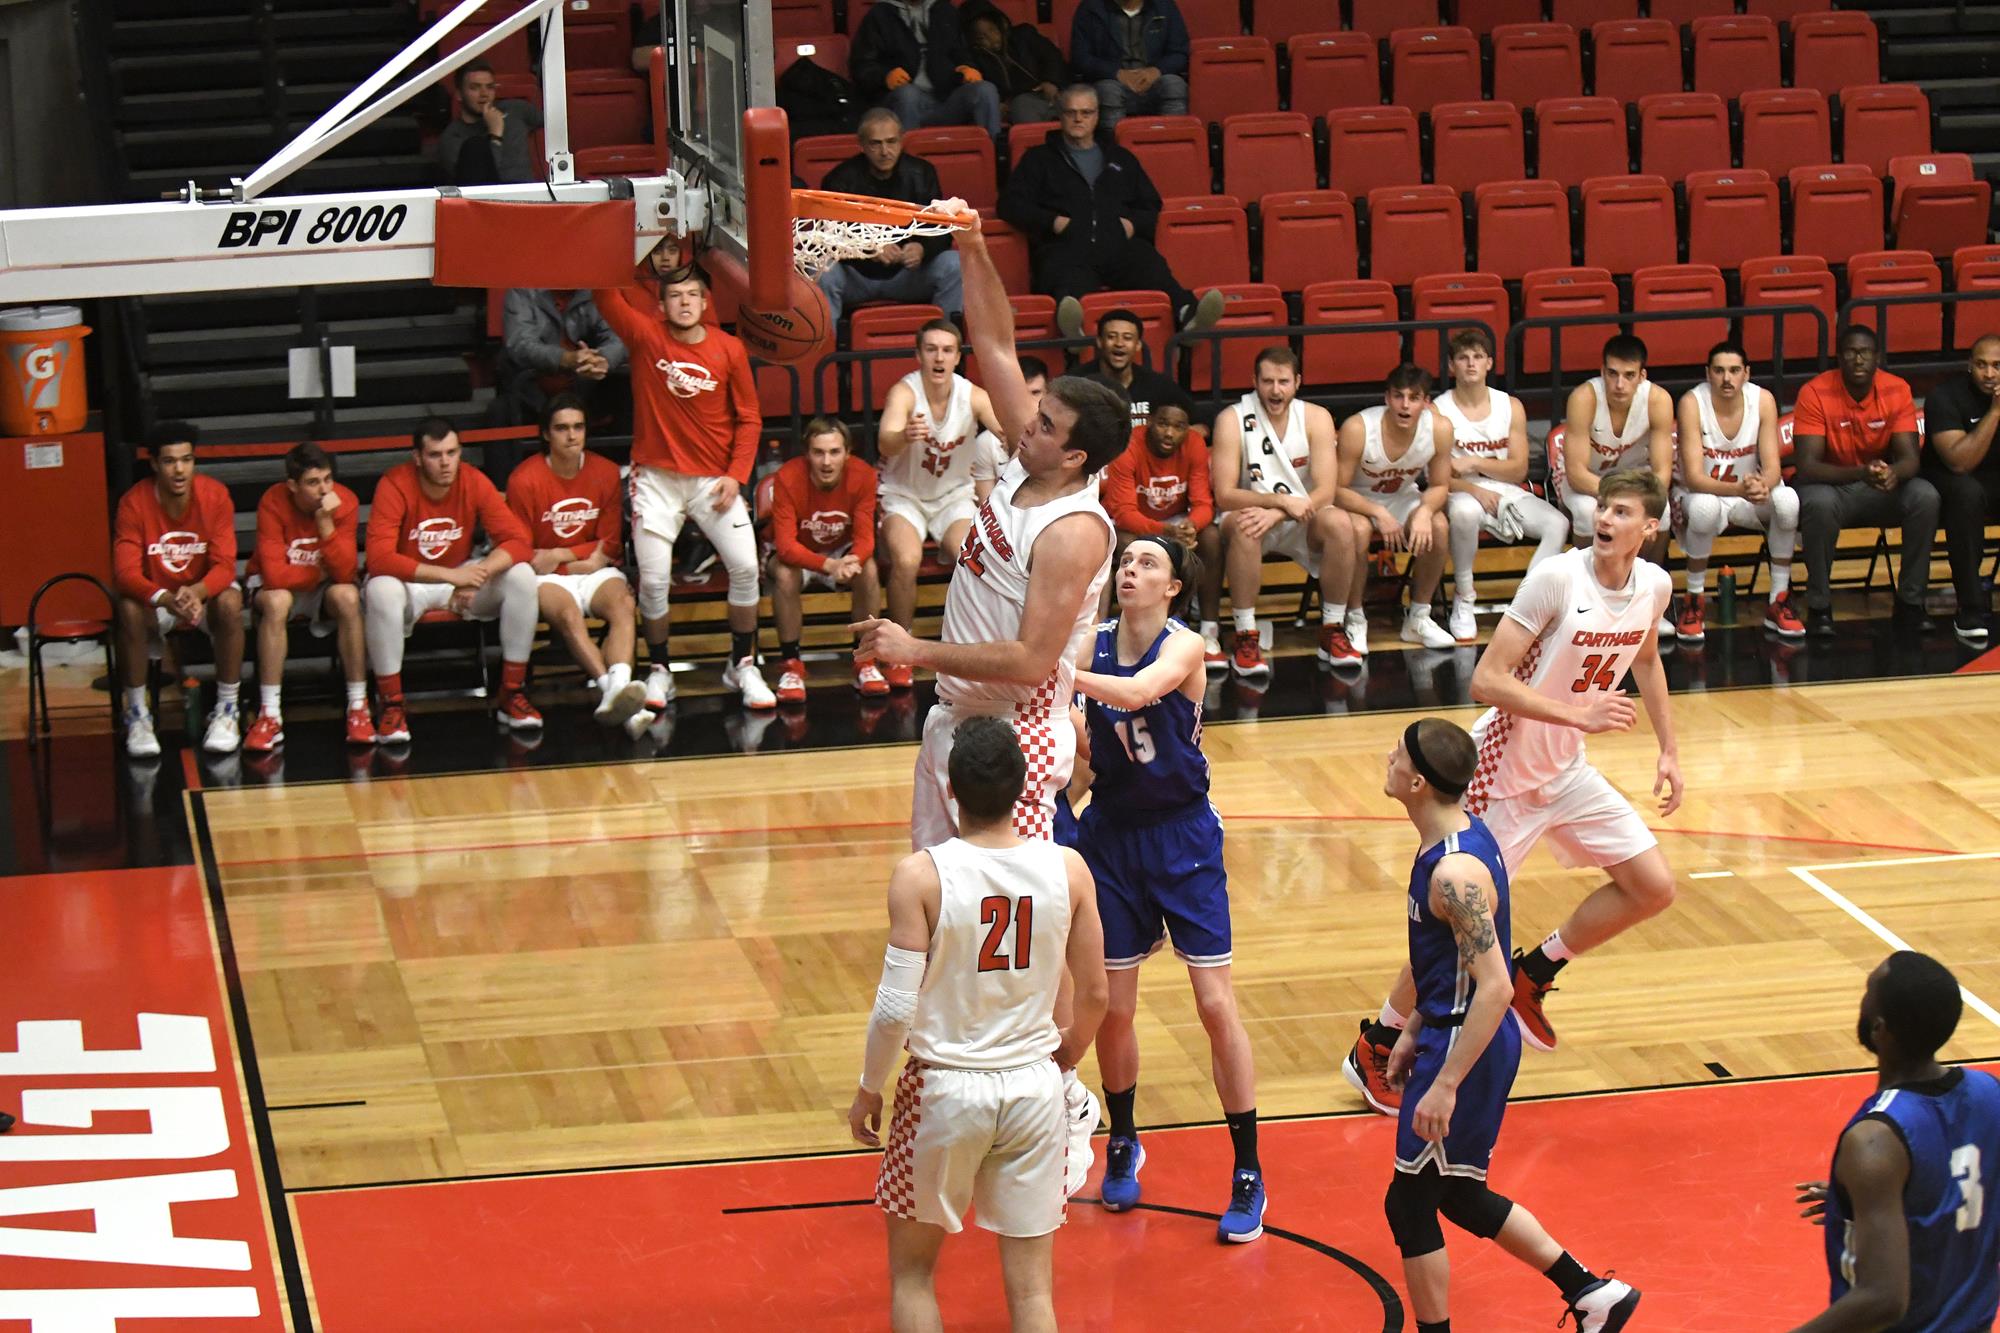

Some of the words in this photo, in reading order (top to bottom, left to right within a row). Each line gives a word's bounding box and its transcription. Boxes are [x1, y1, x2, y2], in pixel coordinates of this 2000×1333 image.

[217, 209, 302, 248] BPI
[306, 204, 408, 245] 8000
[26, 348, 55, 379] G
[656, 359, 719, 392] CARTHAGE
[541, 507, 601, 522] CARTHAGE
[979, 495, 1015, 563] ARTHAGE
[147, 542, 208, 556] CARTHAGE
[407, 526, 464, 542] CARTHAGE
[1571, 629, 1646, 647] CARTHAGE
[1571, 653, 1620, 693] 34
[1114, 716, 1156, 765] 15
[977, 895, 1033, 973] 21
[1950, 1143, 1985, 1233] 3
